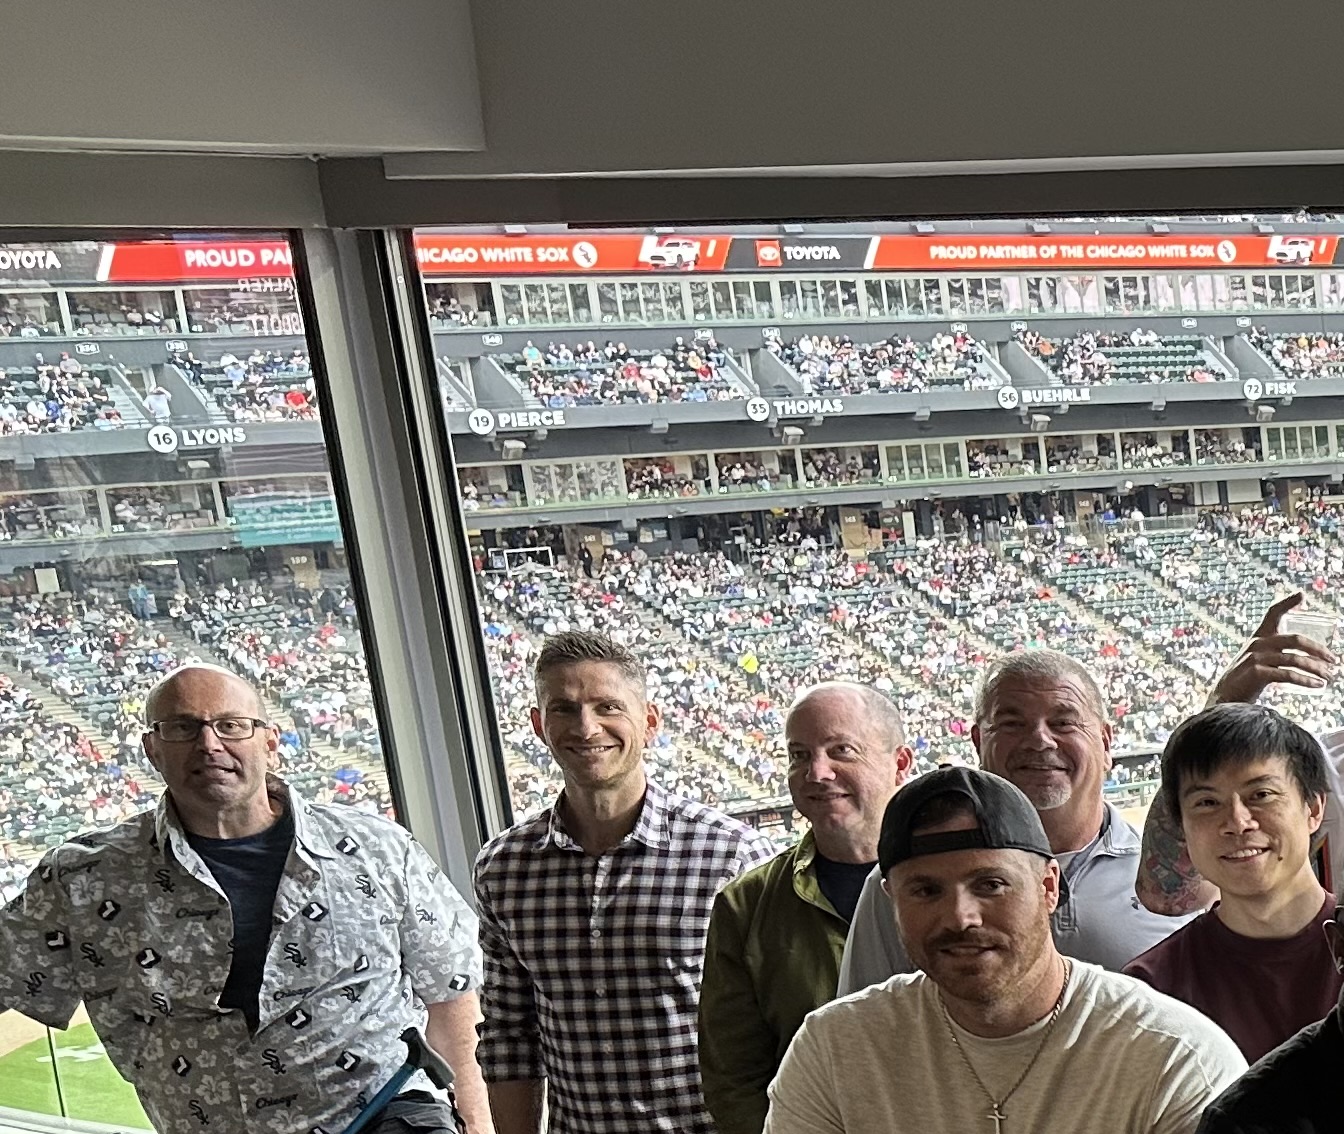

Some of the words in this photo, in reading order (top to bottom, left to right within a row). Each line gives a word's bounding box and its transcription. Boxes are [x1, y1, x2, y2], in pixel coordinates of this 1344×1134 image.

[184, 249, 254, 268] PROUD
[480, 247, 533, 263] WHITE
[535, 246, 569, 262] SOX
[784, 246, 841, 261] TOYOTA
[929, 245, 977, 260] PROUD
[979, 245, 1037, 259] PARTNER
[1040, 245, 1057, 259] OF
[1059, 245, 1085, 259] THE
[1087, 244, 1145, 259] CHICAGO
[1147, 244, 1187, 258] WHITE
[1189, 244, 1215, 258] SOX
[1021, 387, 1091, 403] BUEHRLE
[1265, 381, 1297, 396] FISK
[773, 399, 843, 416] THOMAS
[474, 415, 490, 428] 19
[498, 409, 566, 428] PIERCE
[153, 431, 173, 446] 16
[181, 426, 247, 447] LYONS
